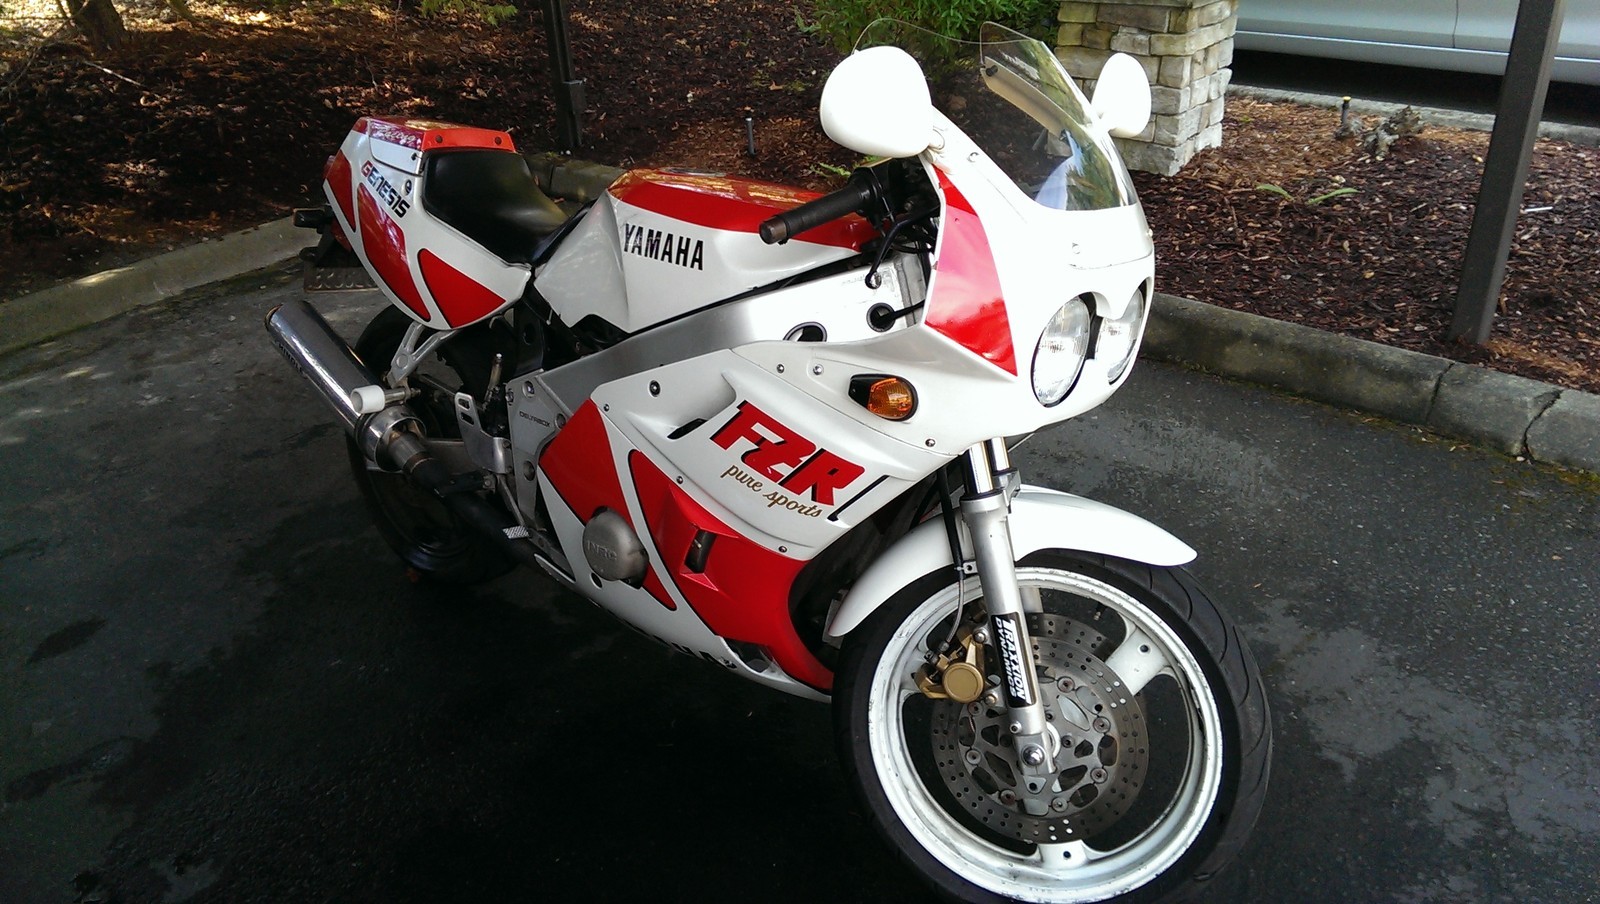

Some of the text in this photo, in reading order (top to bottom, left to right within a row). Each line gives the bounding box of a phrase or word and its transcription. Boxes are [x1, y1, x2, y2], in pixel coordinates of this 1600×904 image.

[361, 160, 411, 218] GENESIS
[624, 223, 704, 271] YAMAHA
[709, 400, 865, 506] FZR
[720, 465, 823, 518] pure sports
[996, 617, 1017, 698] DYNAMICS
[1003, 618, 1032, 704] TRAXXION
